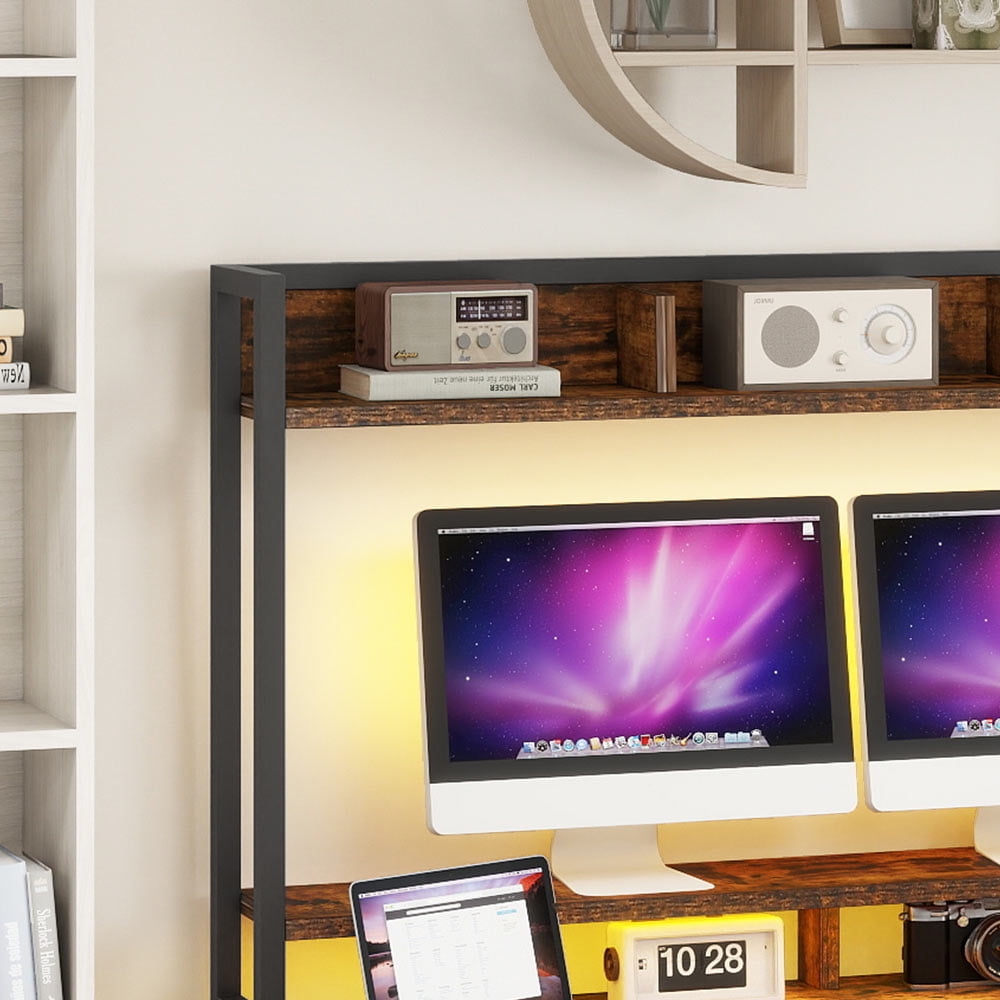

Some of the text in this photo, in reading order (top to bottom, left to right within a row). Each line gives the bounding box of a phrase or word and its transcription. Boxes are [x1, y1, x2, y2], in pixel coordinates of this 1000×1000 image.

[489, 383, 539, 392] CARL MOSER
[3, 921, 21, 962] soledad
[37, 908, 54, 949] Sherlock
[8, 963, 23, 977] de
[40, 950, 56, 985] Holmes
[660, 943, 744, 977] 10 28
